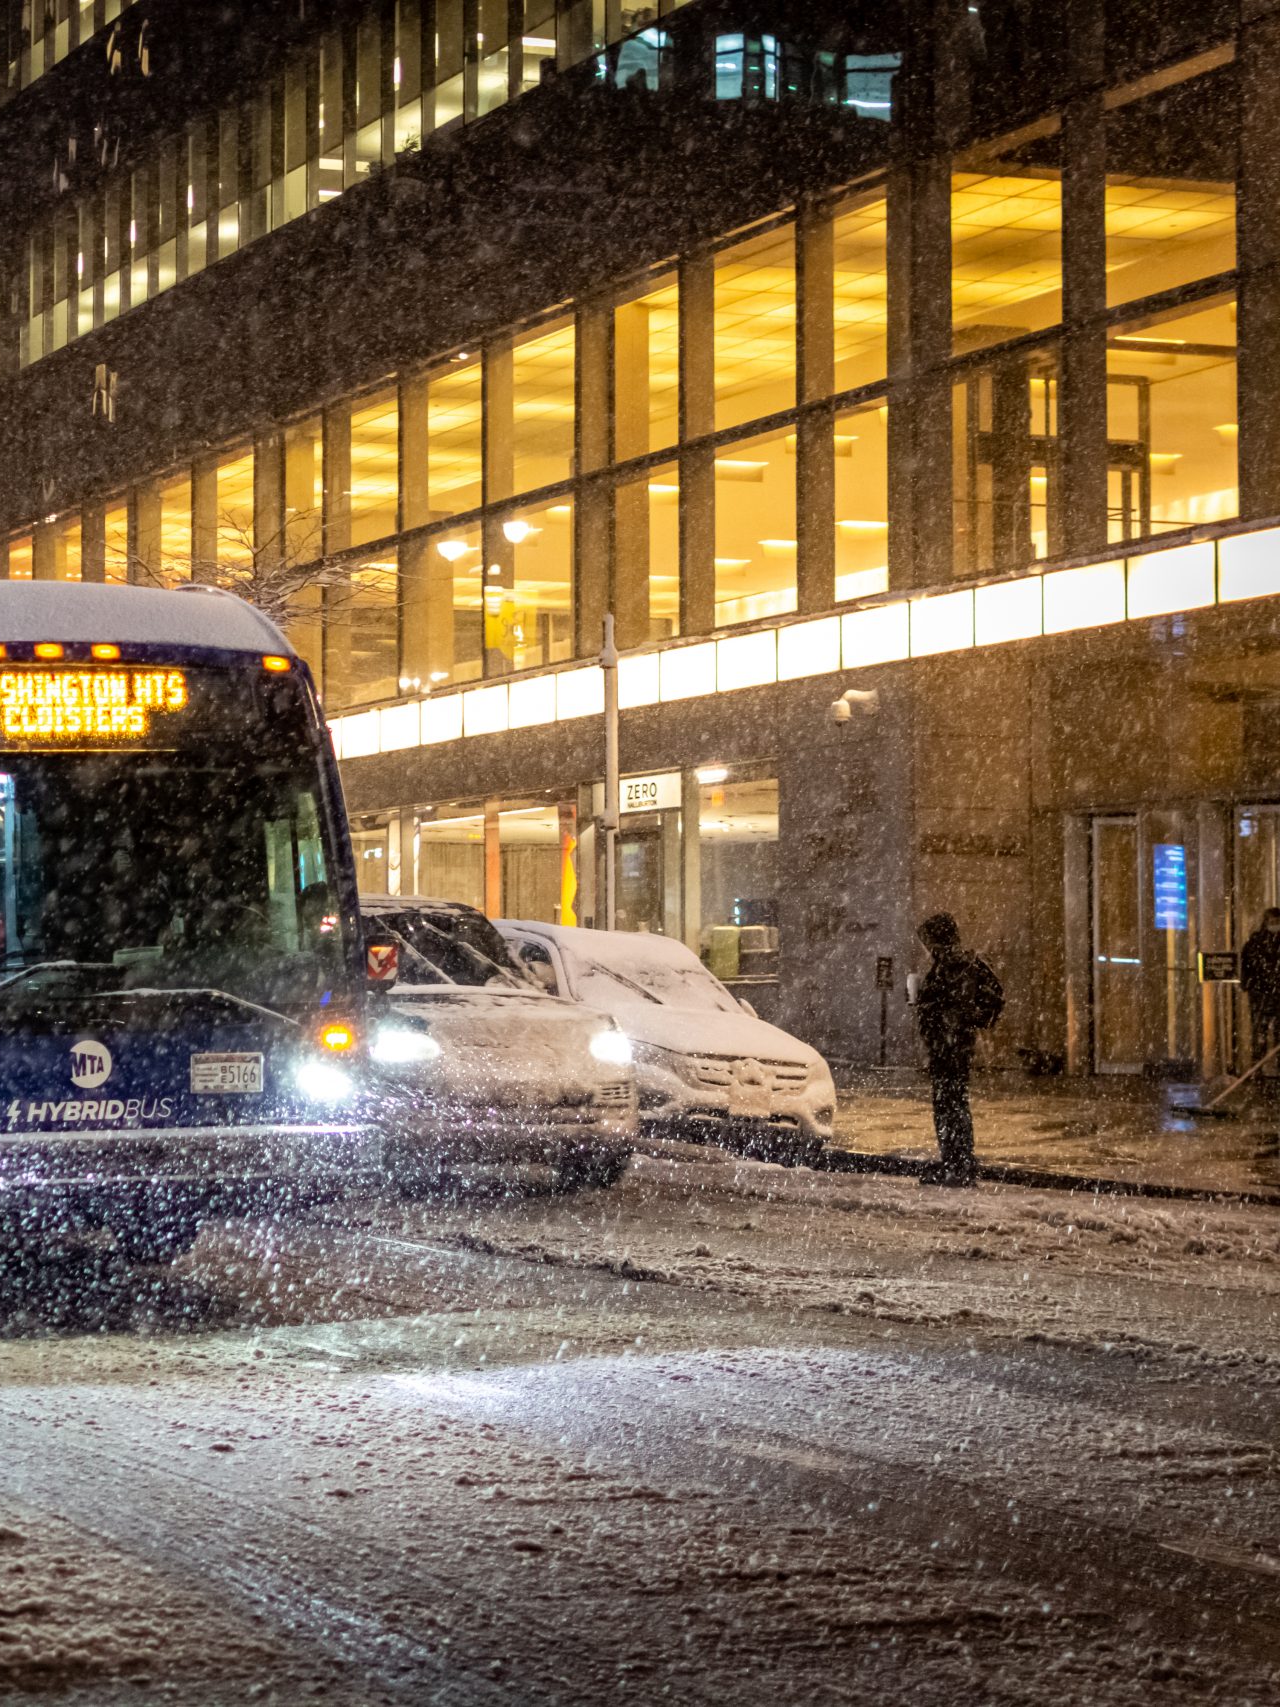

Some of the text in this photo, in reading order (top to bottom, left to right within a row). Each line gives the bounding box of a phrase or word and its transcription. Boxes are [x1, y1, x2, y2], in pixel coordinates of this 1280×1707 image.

[132, 672, 185, 706] HTS
[1, 704, 147, 735] CLOISTERS
[627, 782, 657, 799] ZERO
[70, 1051, 105, 1078] MTA
[228, 1065, 256, 1084] 5166
